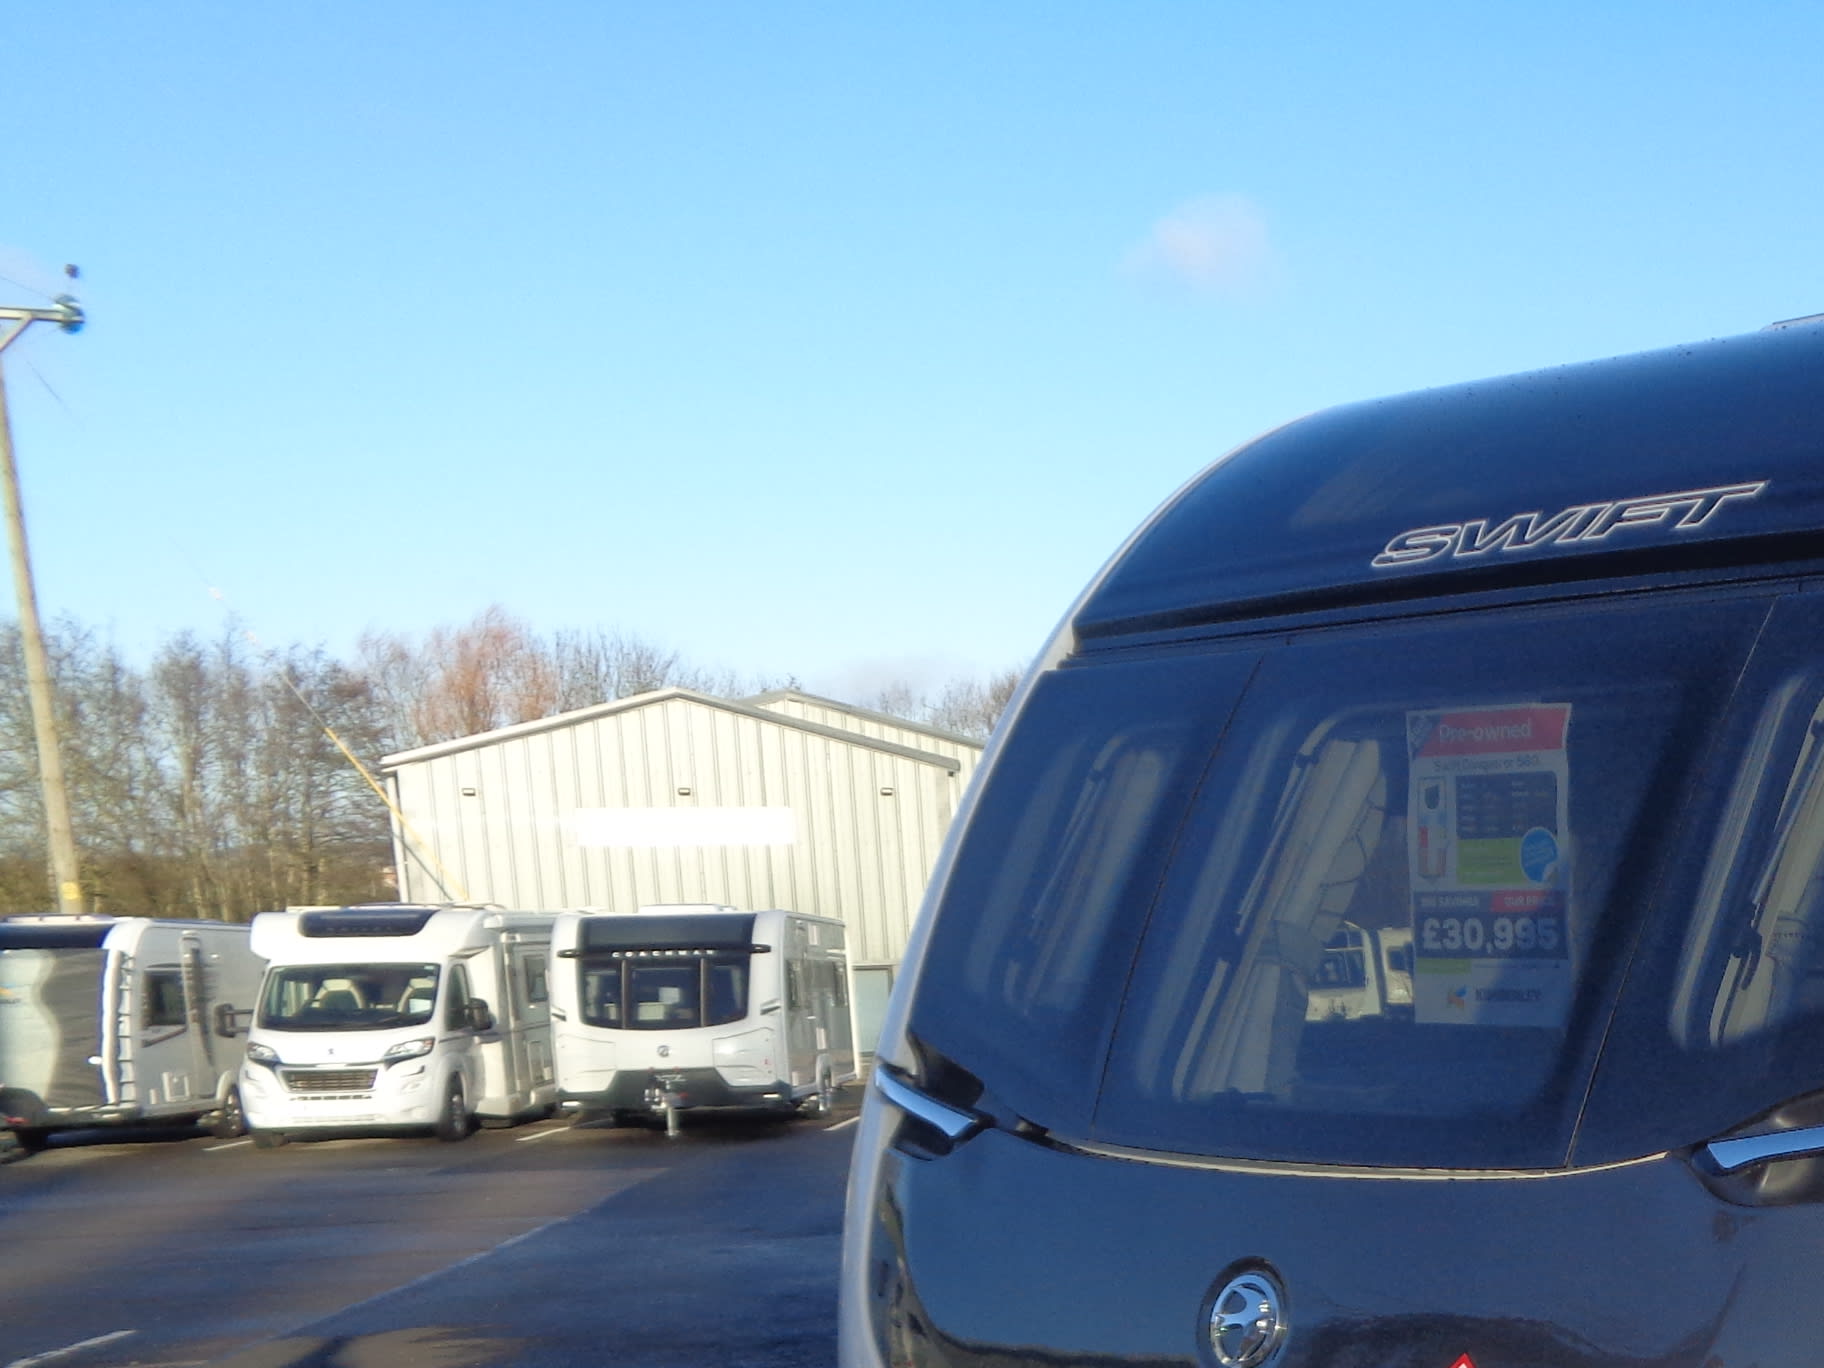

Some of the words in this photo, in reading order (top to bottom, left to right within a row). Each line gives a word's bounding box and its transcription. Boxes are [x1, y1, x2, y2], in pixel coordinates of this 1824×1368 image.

[1371, 480, 1770, 568] SWIFT
[1439, 719, 1532, 742] Pre-owned
[1422, 917, 1559, 954] £30,995
